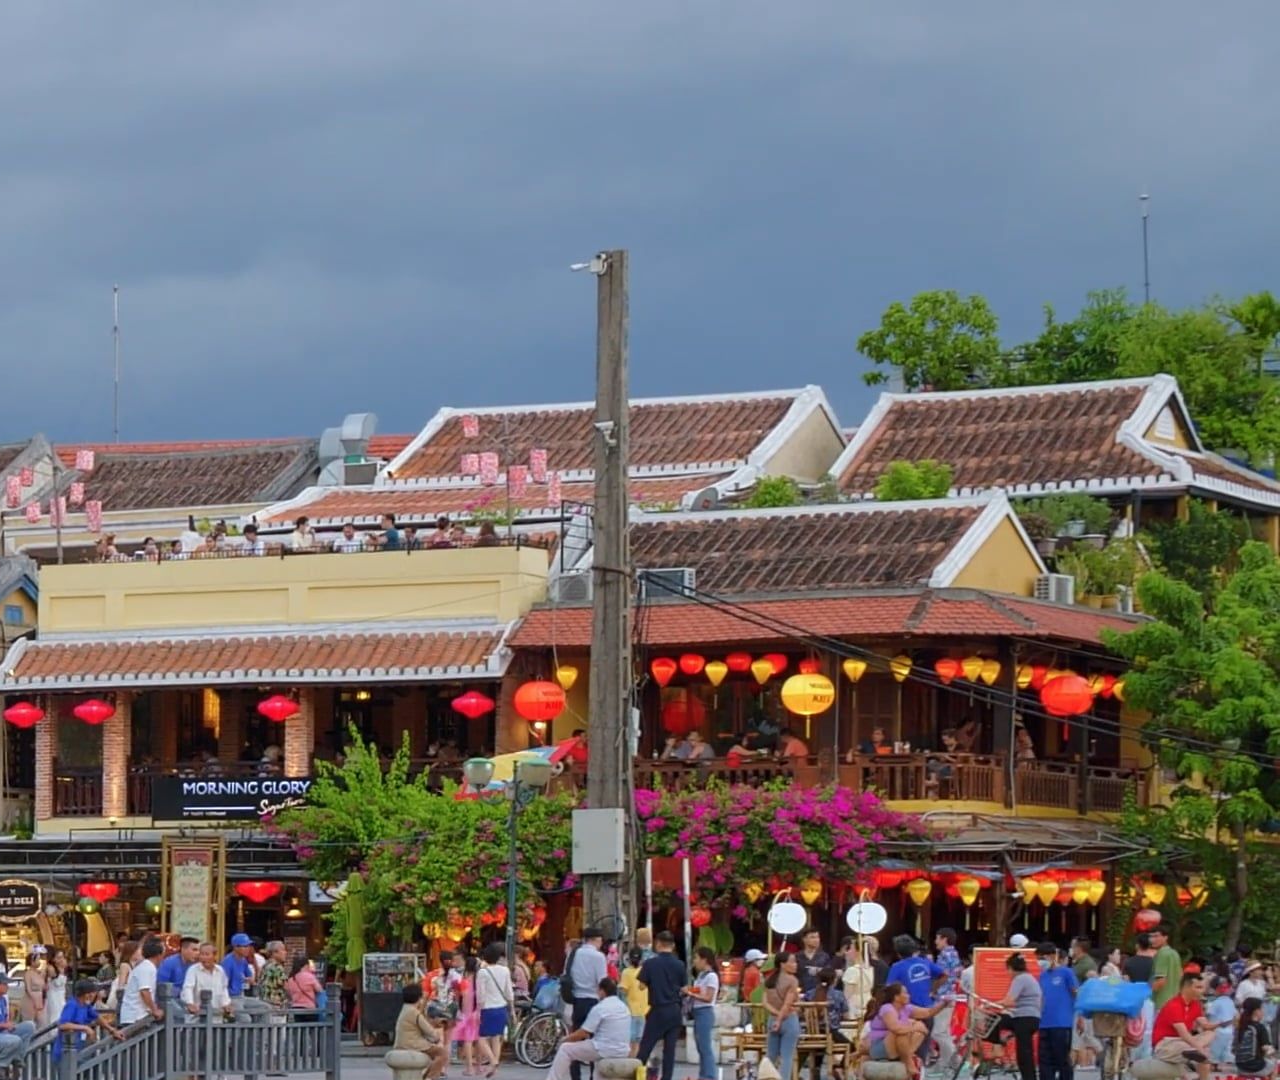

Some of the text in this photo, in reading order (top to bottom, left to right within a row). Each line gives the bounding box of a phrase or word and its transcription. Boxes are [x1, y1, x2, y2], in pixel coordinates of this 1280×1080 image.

[183, 781, 310, 795] MORNING GLORY
[14, 897, 34, 905] DELI
